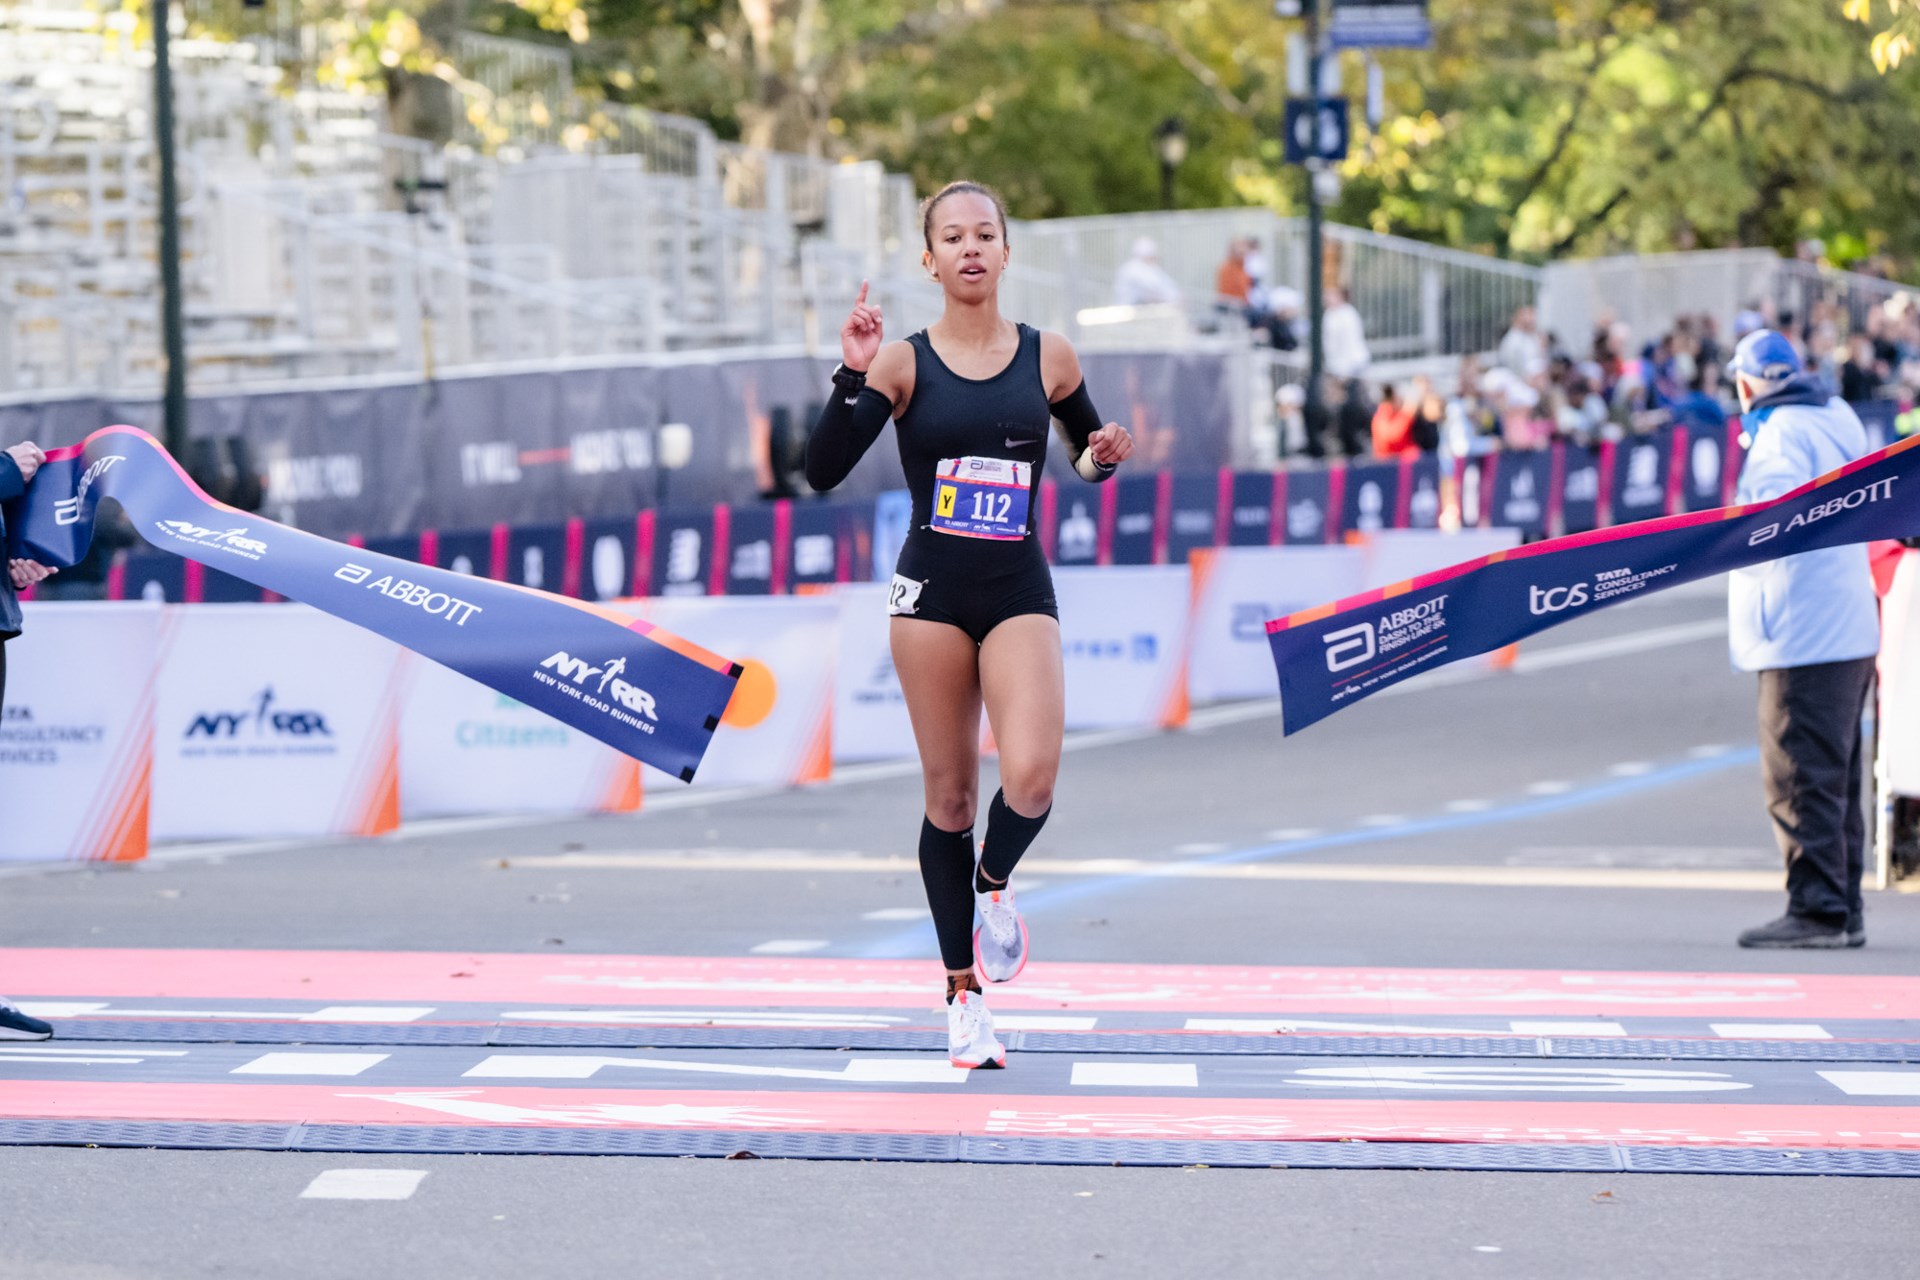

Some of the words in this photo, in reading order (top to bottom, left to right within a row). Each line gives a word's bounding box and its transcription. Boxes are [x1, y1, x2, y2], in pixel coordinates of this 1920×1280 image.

[943, 495, 952, 509] Y
[970, 491, 1012, 523] 112
[1784, 476, 1899, 532] ABBOTT
[1593, 580, 1646, 601] SERVICES
[1595, 568, 1632, 582] TATA
[1595, 563, 1678, 592] CONSULTANCY
[366, 575, 483, 626] ABBOTT
[1378, 594, 1449, 634] ABBOTT
[1530, 583, 1588, 615] tcs
[1379, 627, 1407, 645] DASH
[1408, 621, 1422, 633] TO
[1422, 612, 1442, 626] THE
[1379, 634, 1411, 654] FINISH
[1411, 625, 1432, 640] LINE
[533, 670, 557, 686] NEW
[557, 681, 583, 700] YORK
[582, 694, 610, 713] ROAD
[609, 708, 656, 735] RUNNERS
